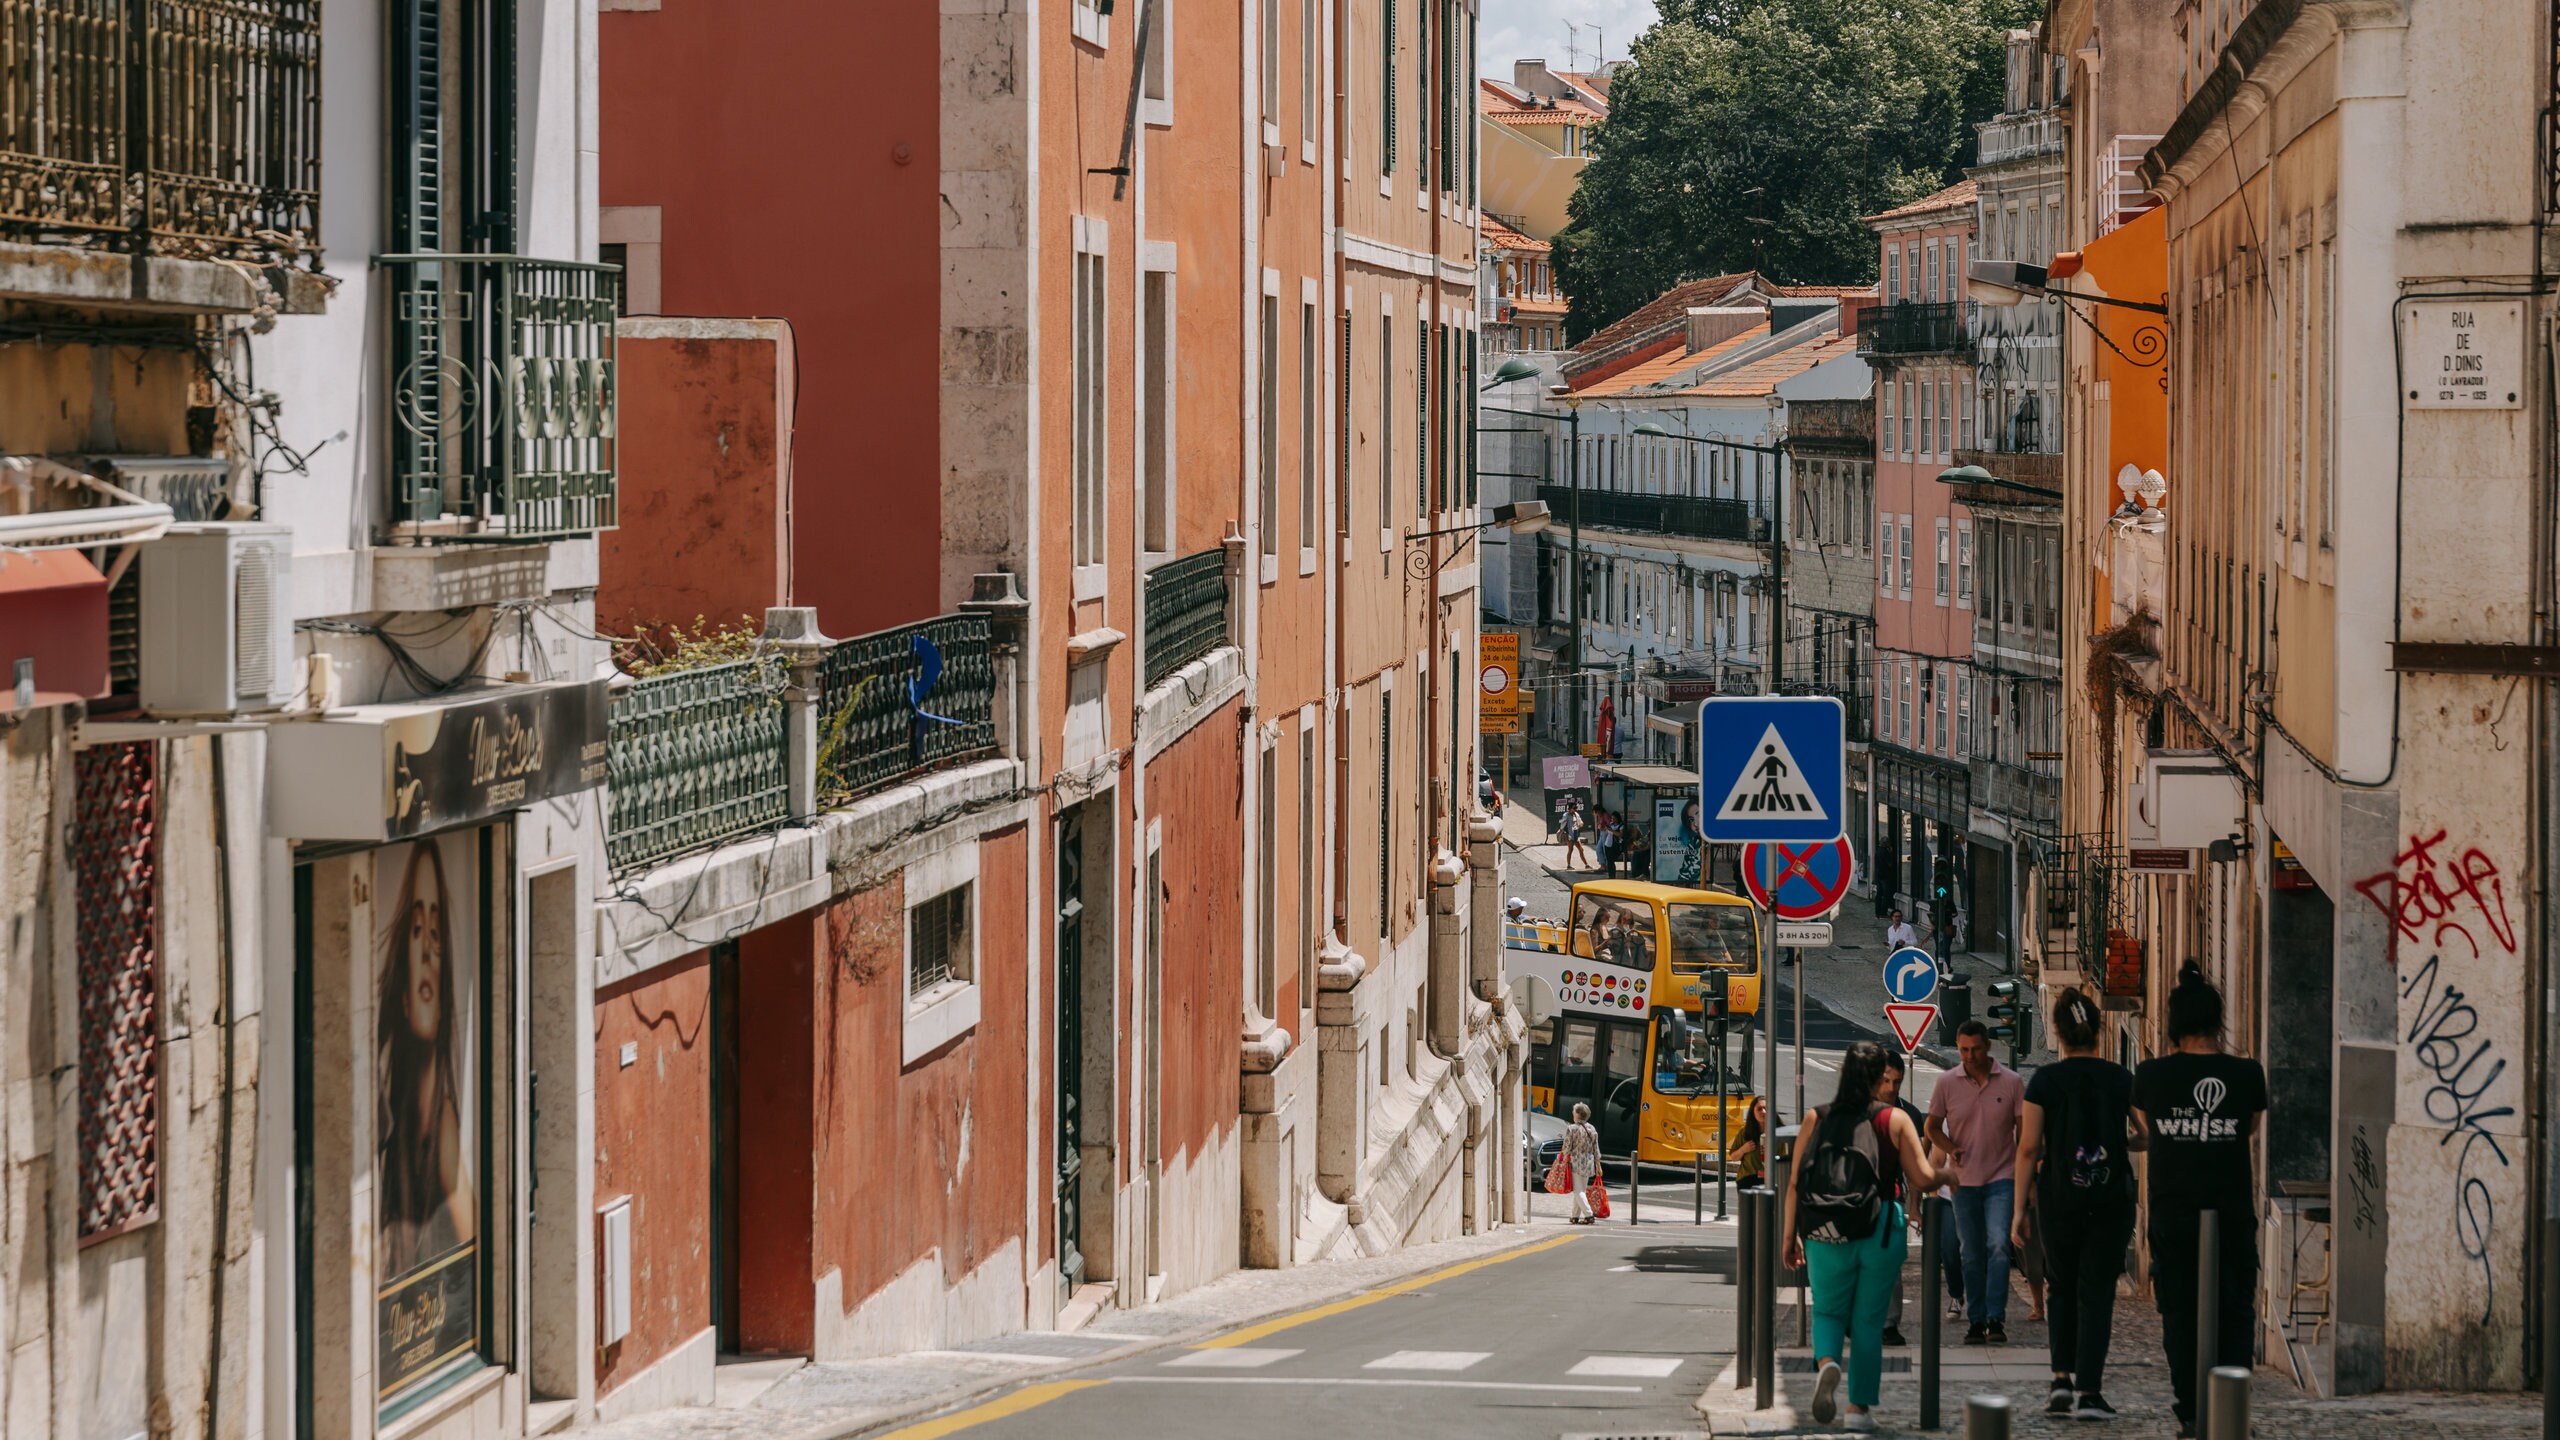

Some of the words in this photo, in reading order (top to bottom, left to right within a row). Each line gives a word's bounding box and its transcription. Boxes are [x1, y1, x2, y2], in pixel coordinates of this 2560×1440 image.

[2452, 311, 2475, 328] RUA
[2456, 333, 2470, 350] DE
[1480, 636, 1515, 644] TENÇÃO
[1674, 685, 1710, 693] Rodas
[1786, 931, 1797, 939] 8H
[2170, 1106, 2196, 1117] THE
[2155, 1113, 2240, 1142] WHISK
